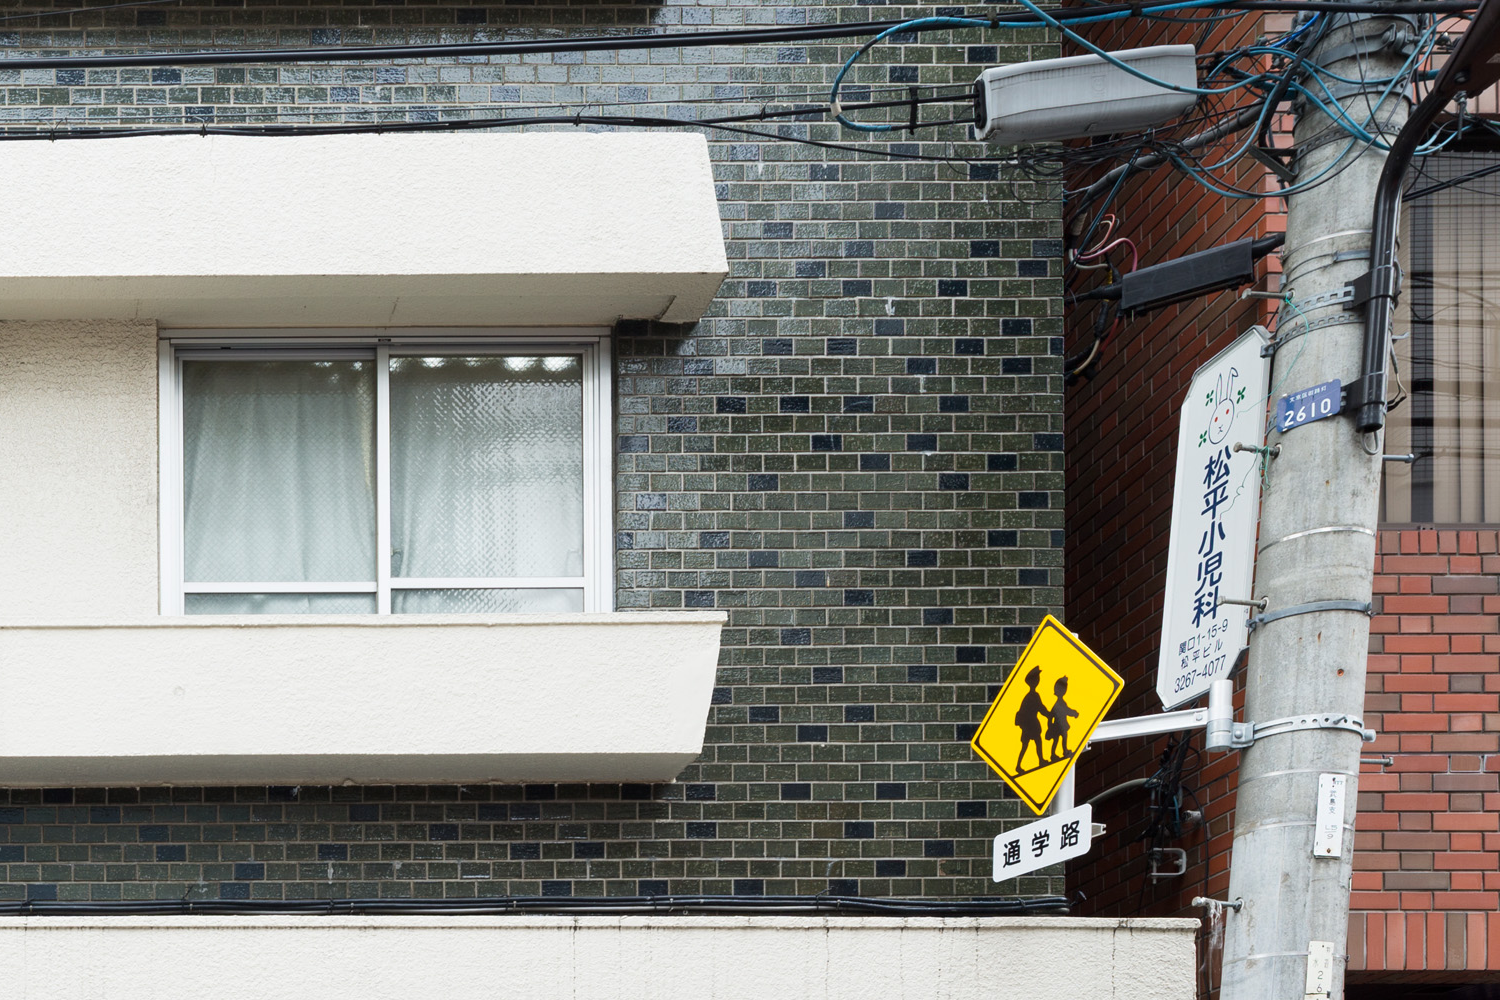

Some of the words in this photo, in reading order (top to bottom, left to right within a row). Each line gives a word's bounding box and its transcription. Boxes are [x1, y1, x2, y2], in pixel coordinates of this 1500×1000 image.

[1284, 398, 1331, 427] 2610
[1191, 445, 1231, 628] 松平小児科
[1174, 654, 1226, 693] 3267-4077
[1181, 638, 1223, 670] 松平ビル
[1003, 820, 1080, 868] 通学路
